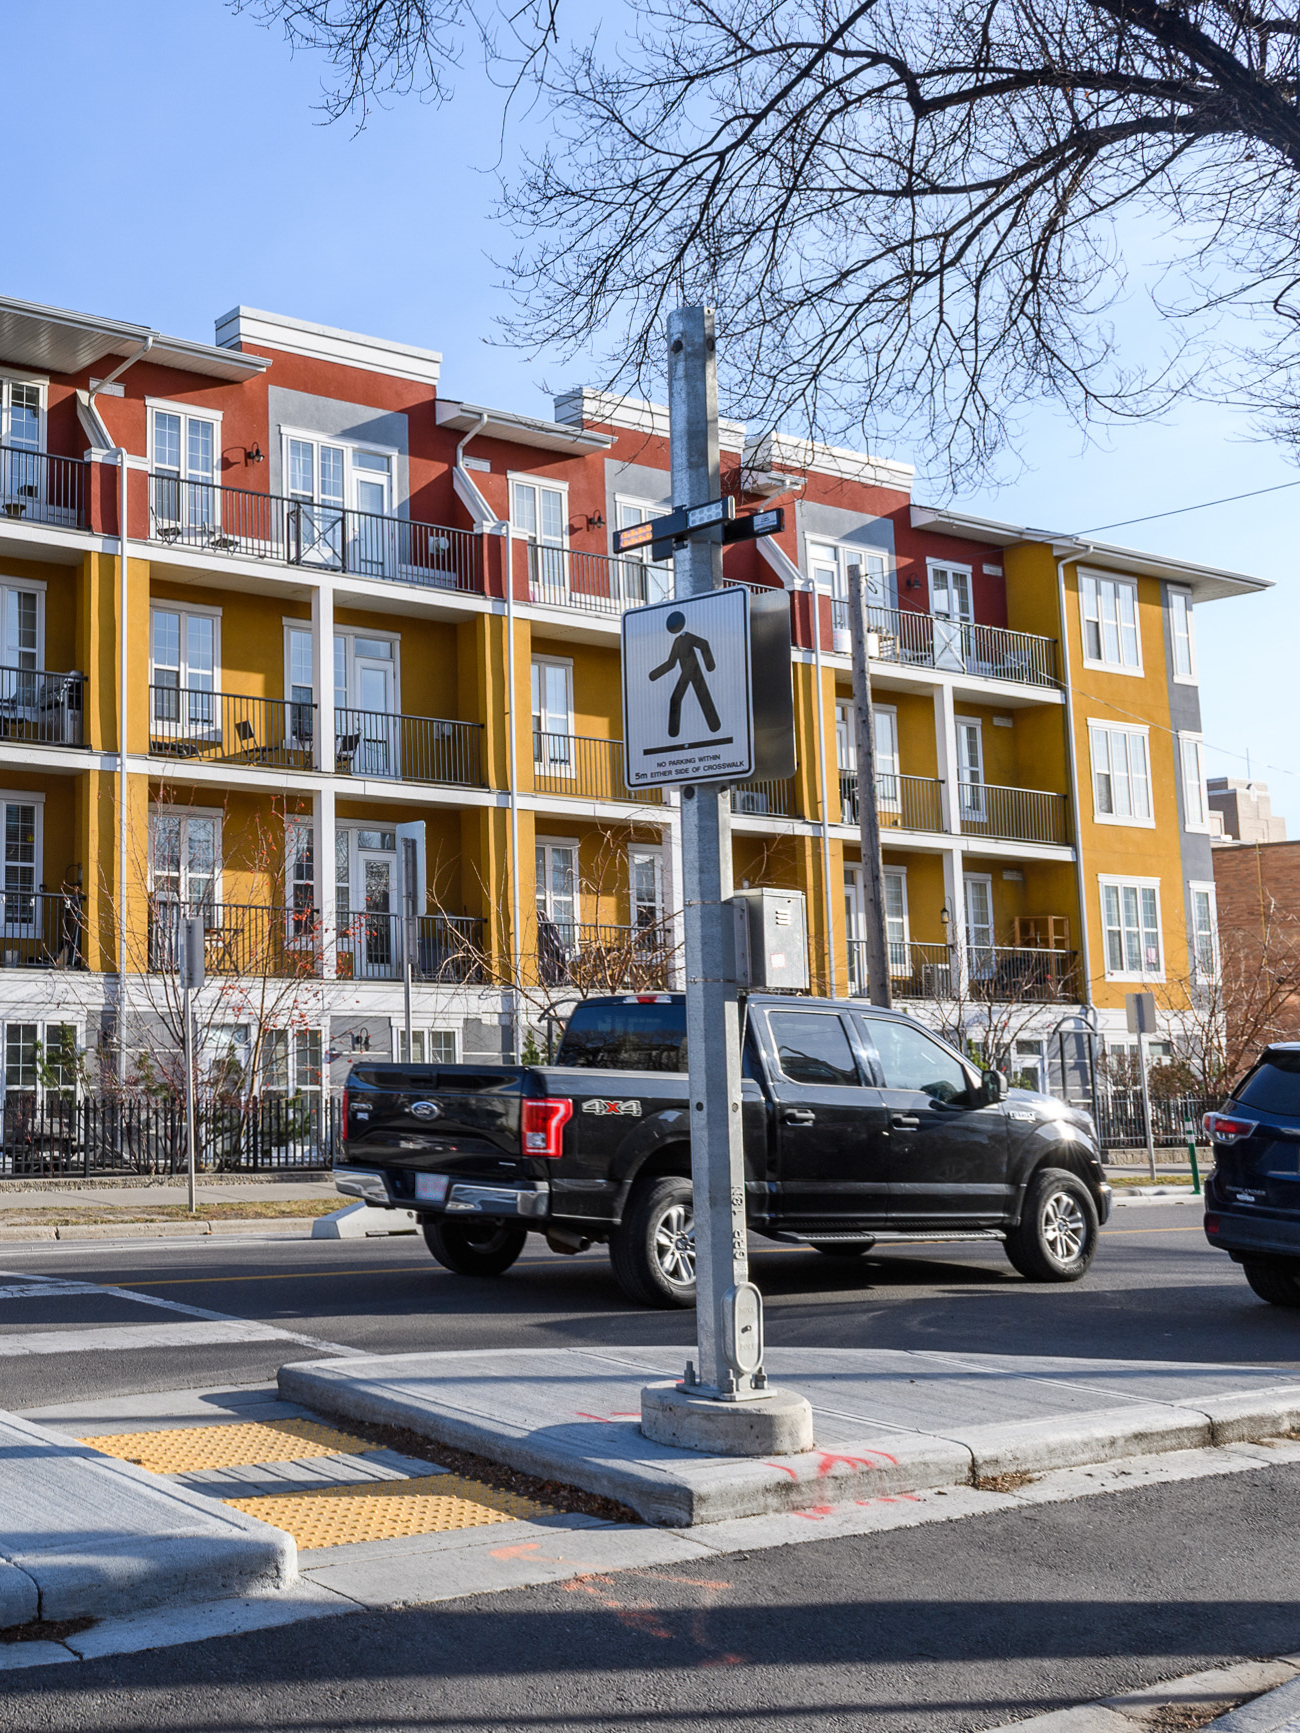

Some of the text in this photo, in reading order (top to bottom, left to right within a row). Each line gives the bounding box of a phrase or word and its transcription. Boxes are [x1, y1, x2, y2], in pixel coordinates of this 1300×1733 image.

[668, 757, 696, 767] PARKING
[698, 754, 721, 763] WITHIN
[635, 772, 648, 780] 5m
[650, 769, 673, 778] EITHER
[675, 767, 690, 776] SIDE
[703, 760, 745, 772] CROSSWALK
